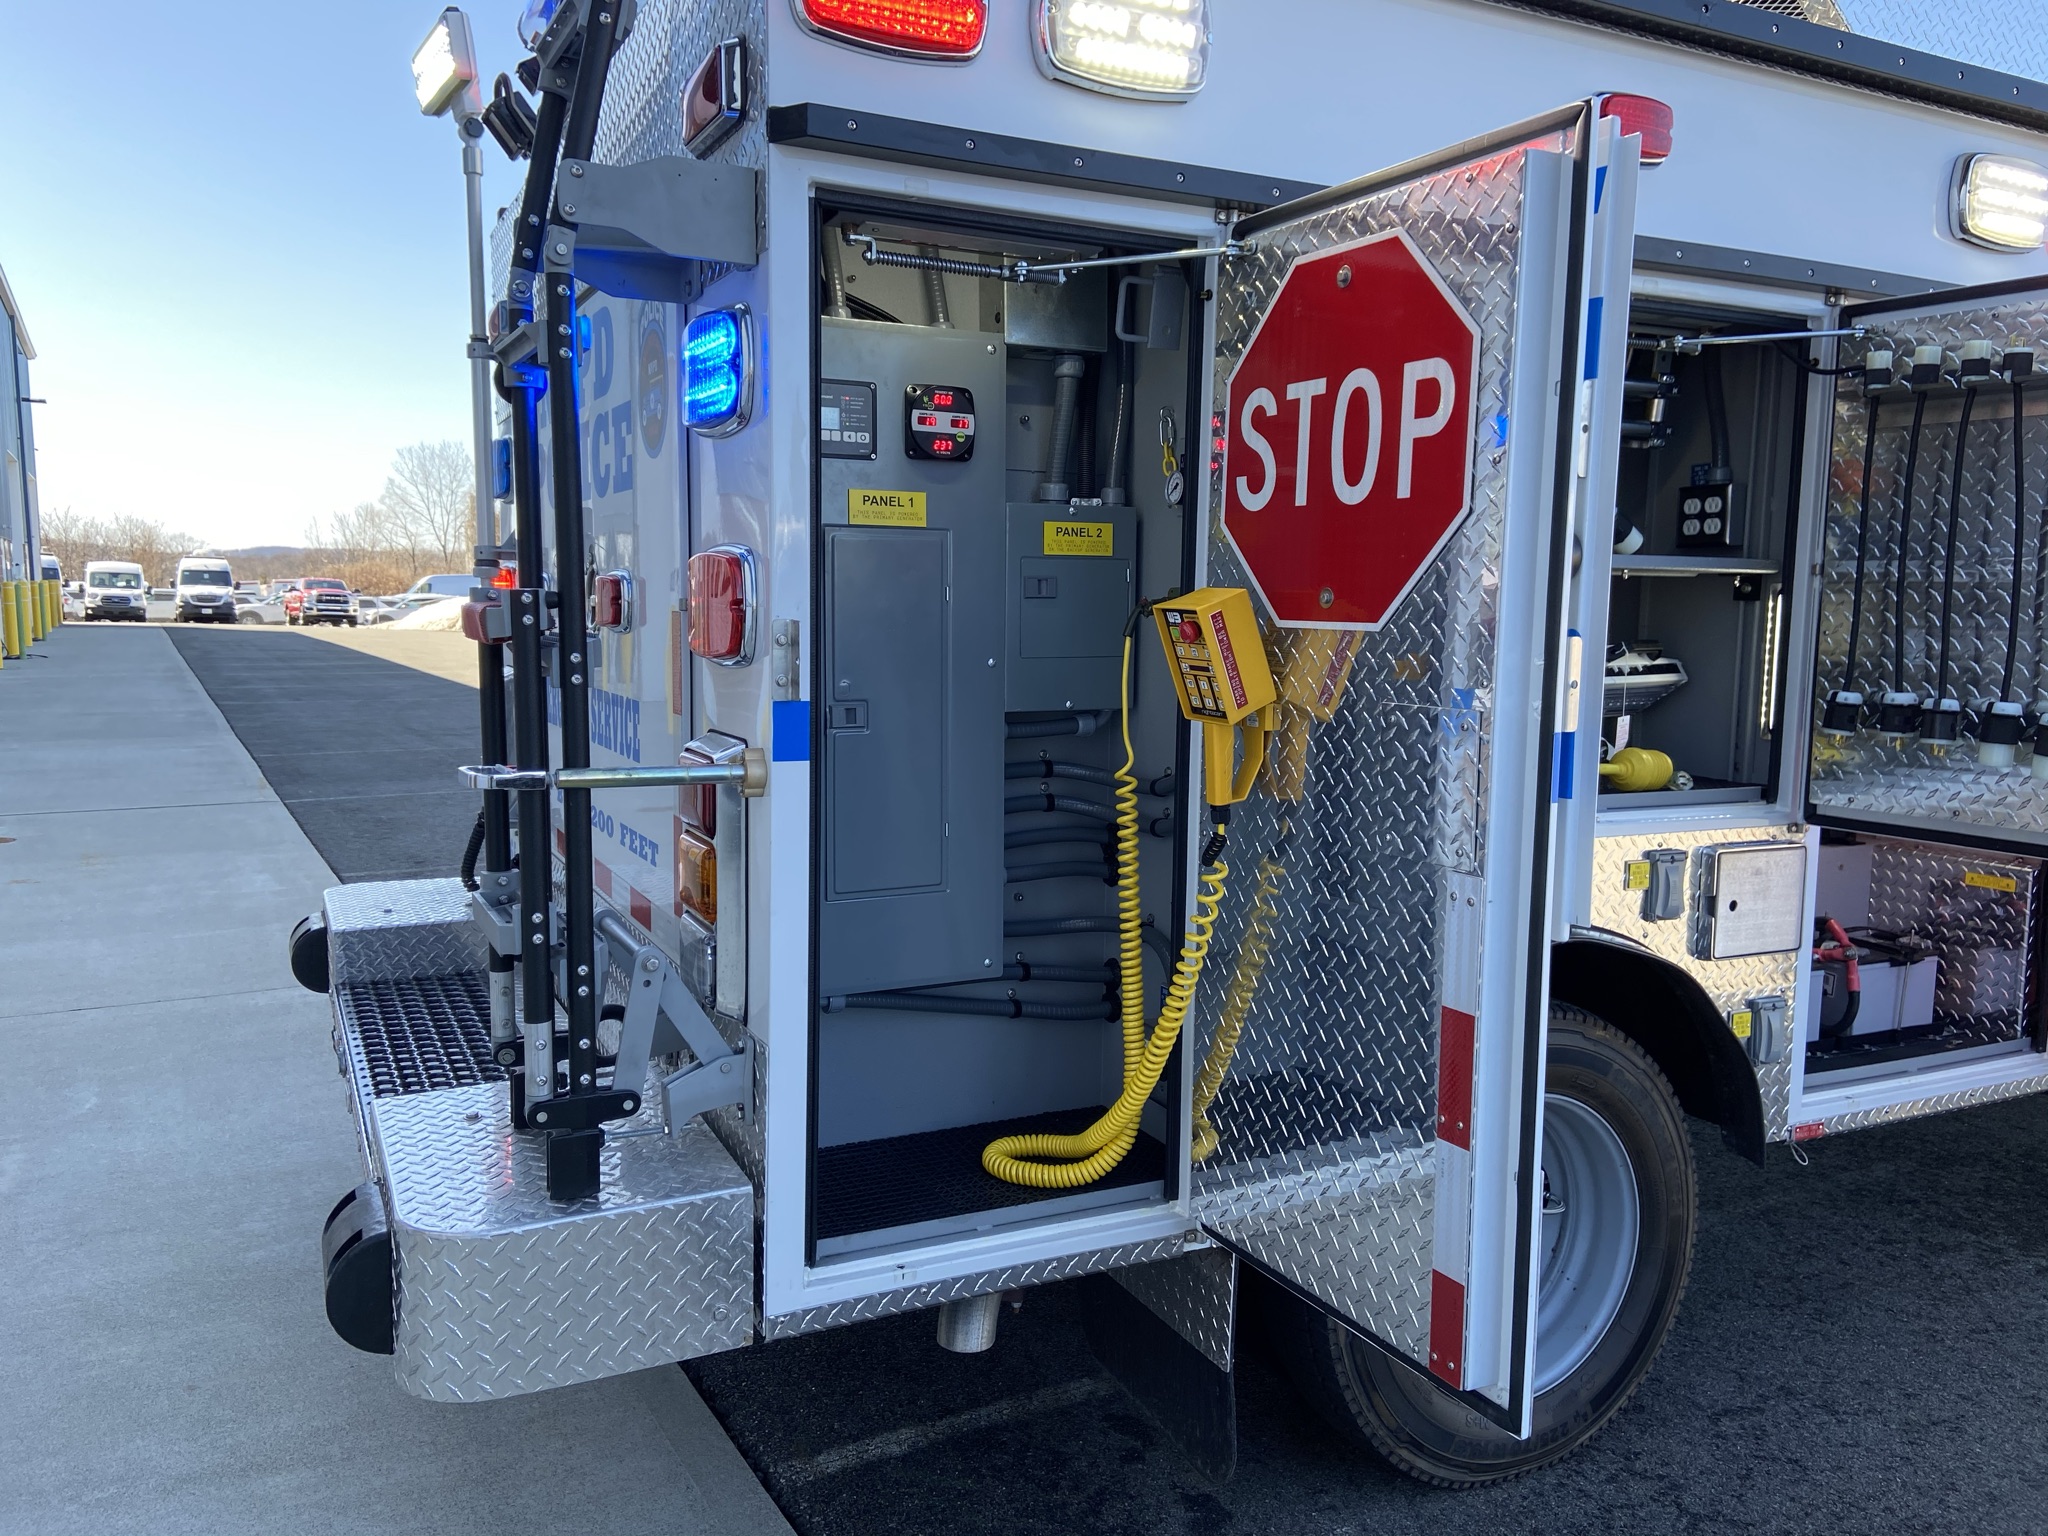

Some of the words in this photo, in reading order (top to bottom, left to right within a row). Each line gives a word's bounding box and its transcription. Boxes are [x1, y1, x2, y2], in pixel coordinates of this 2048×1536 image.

[926, 417, 936, 426] 19
[959, 419, 969, 429] 17
[1236, 357, 1456, 512] STOP
[933, 440, 953, 451] 237
[862, 495, 905, 508] PANEL
[908, 497, 914, 508] 1
[1056, 526, 1093, 538] PANEL
[1096, 528, 1103, 538] 2
[591, 688, 640, 763] SERVICE
[591, 805, 614, 838] 200
[620, 822, 659, 867] FEET
